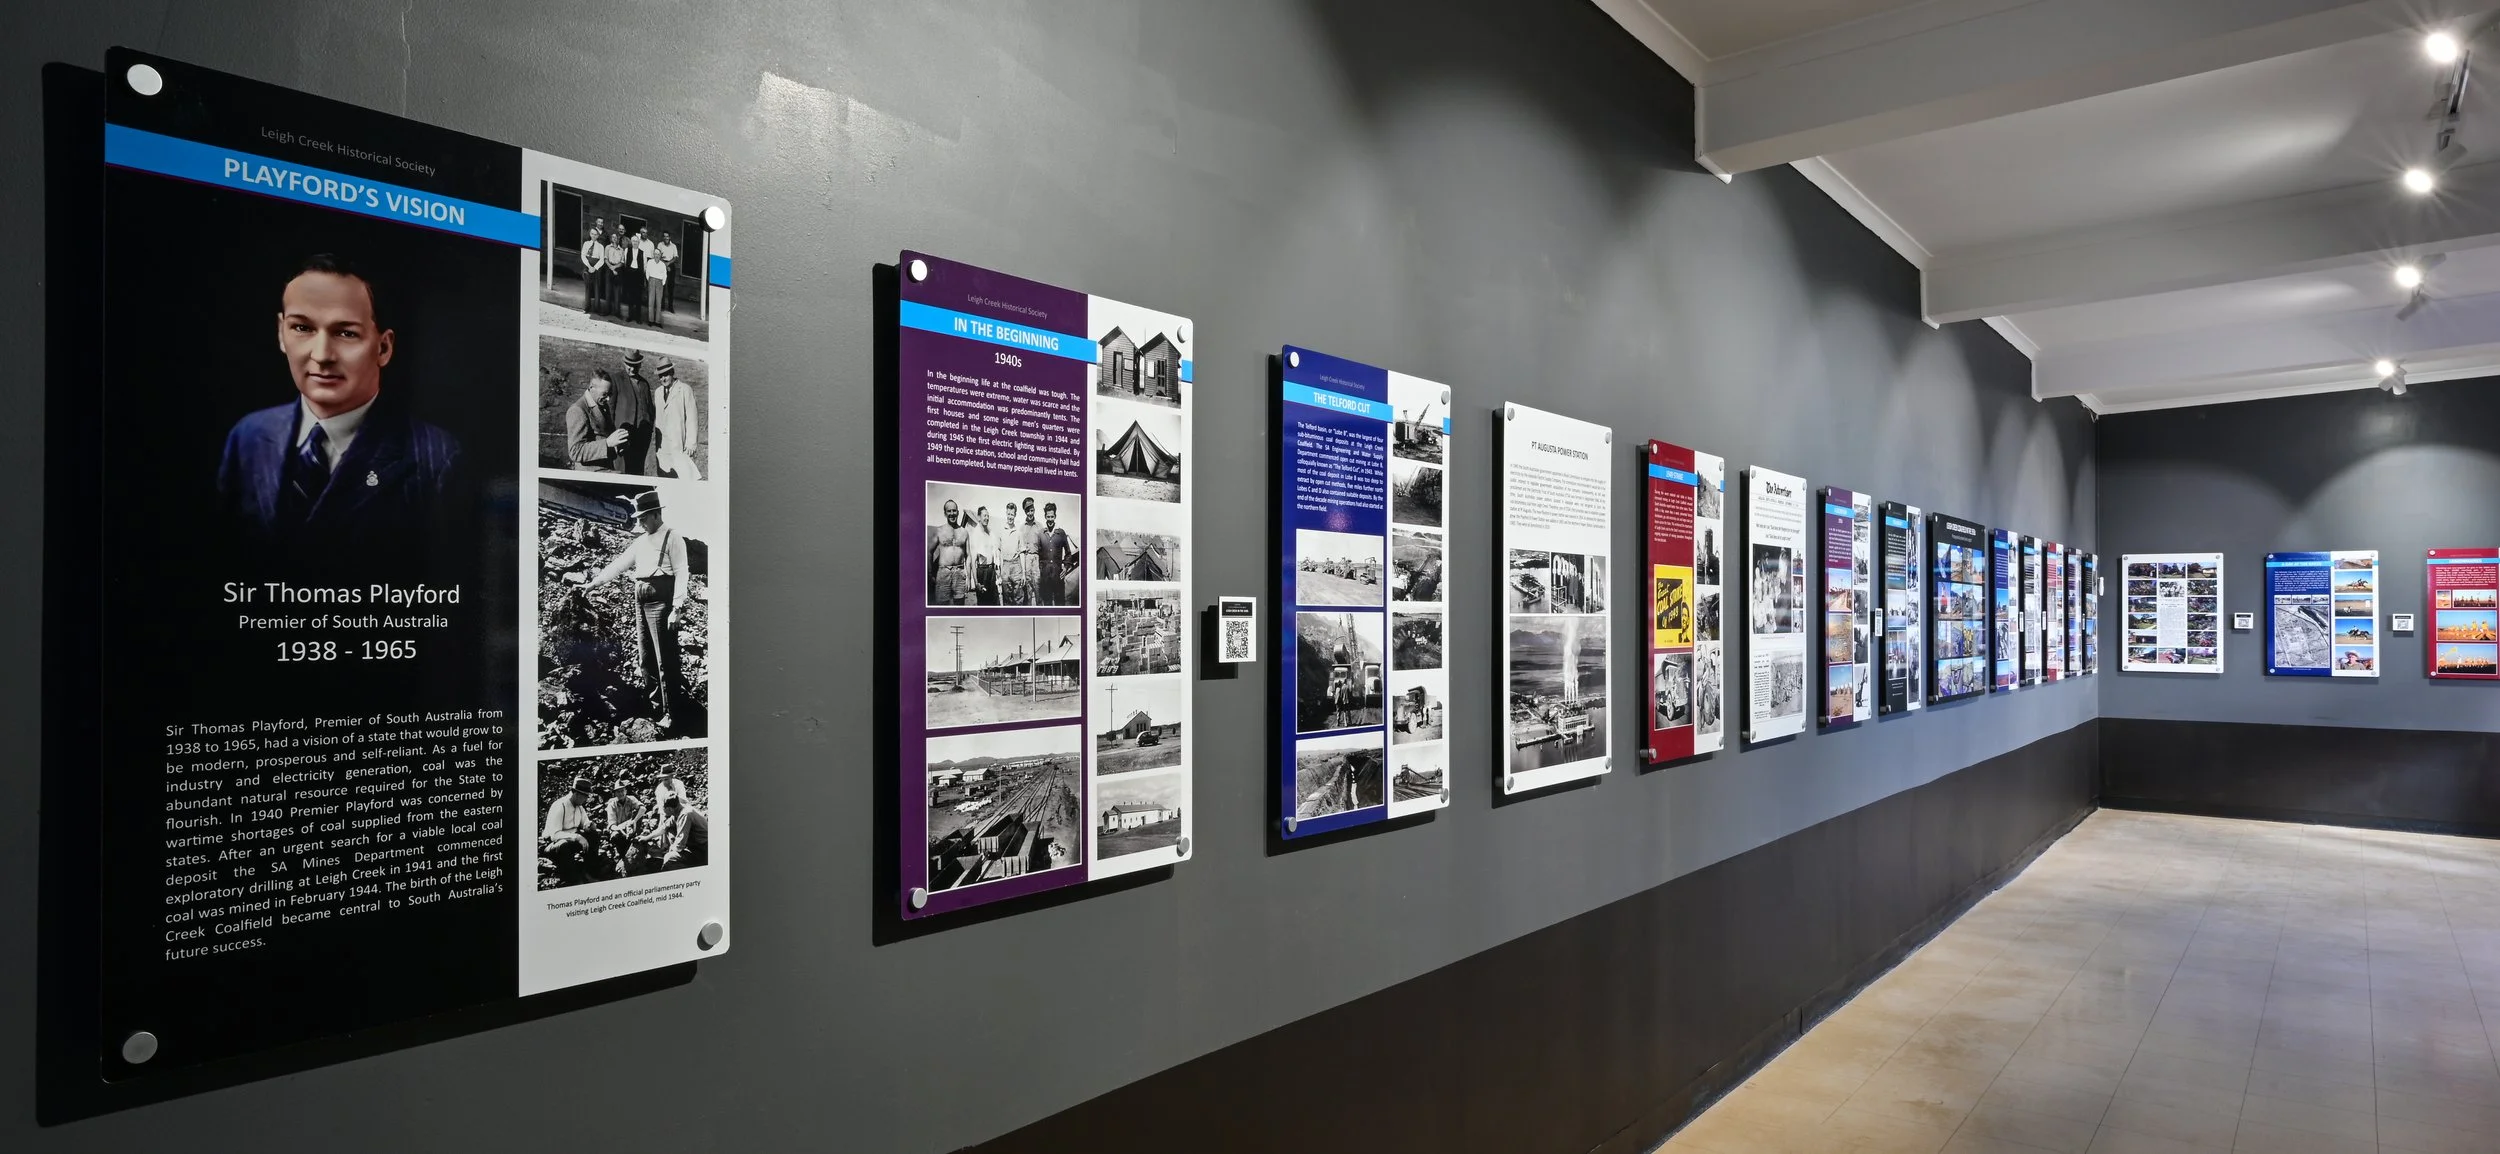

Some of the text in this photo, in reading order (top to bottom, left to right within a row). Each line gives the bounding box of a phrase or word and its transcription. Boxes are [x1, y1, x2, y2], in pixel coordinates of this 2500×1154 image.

[261, 126, 436, 177] Leigh Creek Historical Society
[225, 158, 465, 226] PLAYFORD'S VISION
[967, 294, 1048, 320] Leigh Creek Historical Society
[954, 318, 1059, 351] IN THE BEGINNING
[995, 352, 1022, 368] 1940s
[927, 369, 1081, 402] In the beginning life at the coalfield was tough. The
[927, 382, 1081, 413] temperatures were extreme, water was scarce and the
[1313, 391, 1371, 413] THE TELFORD CUT
[926, 405, 940, 415] first
[943, 407, 965, 419] houses
[967, 412, 980, 421] and
[983, 415, 1000, 423] some
[1002, 416, 1019, 427] single
[1041, 423, 1065, 433] quarters
[1066, 427, 1081, 435] were
[926, 454, 1079, 478] all been completed, but many people still lived in tents.
[223, 582, 460, 608] Sir Thomas Playford
[239, 614, 448, 629] Premier of South Australia
[277, 641, 337, 662] 1938
[362, 640, 417, 660] 1965
[166, 708, 503, 737] Sir Thomas Playford, Premier of South Australia from
[167, 725, 503, 755] 1938 to 1965, had a vision of a state that would grow to
[166, 739, 503, 774] be modern, prosperous and self-reliant. As a fuel for
[165, 866, 503, 924] coal was mined in February 1944. The birth of the Leigh
[546, 901, 573, 910] Thomas
[573, 895, 600, 906] Playford
[601, 893, 614, 902] and
[623, 888, 644, 898] official
[644, 883, 685, 896] parliamentary
[685, 880, 701, 889] party
[566, 891, 684, 918] visiting Leigh Creek Coalfield, mid 1944.
[165, 882, 503, 942] Creek Coalfield became central to South Australia's
[165, 937, 266, 961] future success.
